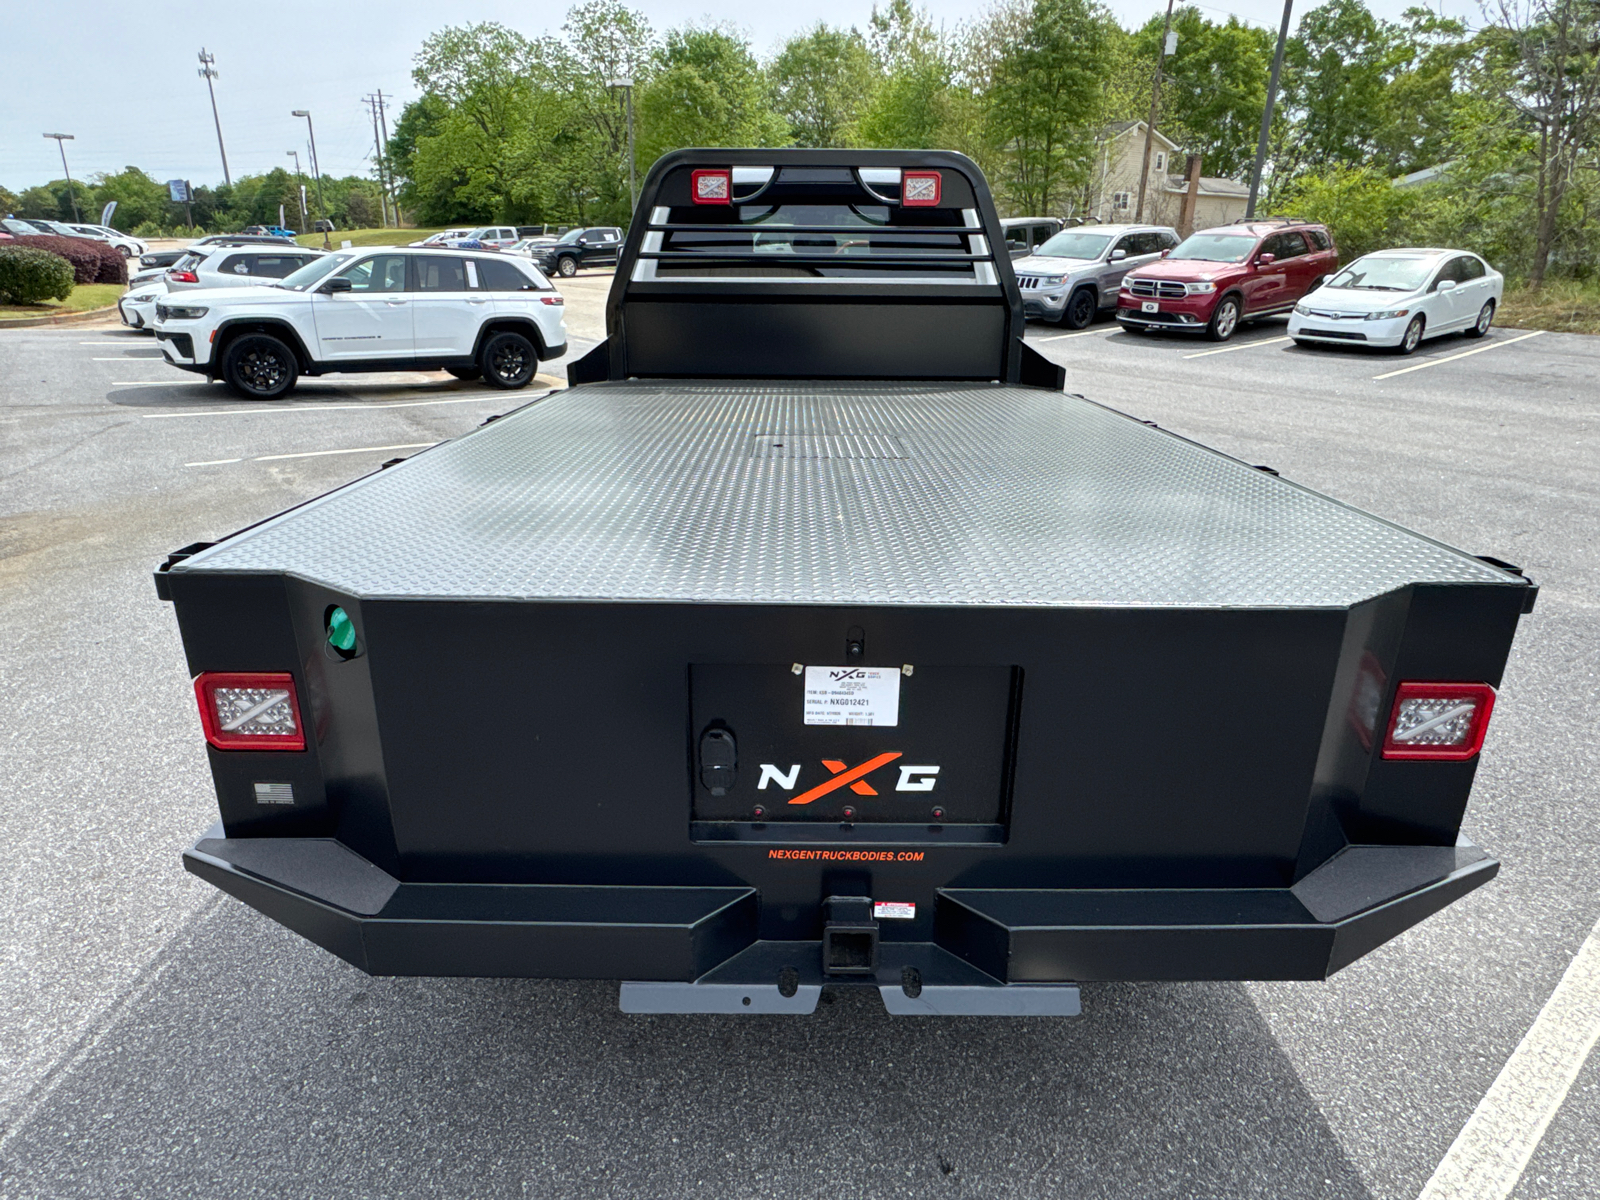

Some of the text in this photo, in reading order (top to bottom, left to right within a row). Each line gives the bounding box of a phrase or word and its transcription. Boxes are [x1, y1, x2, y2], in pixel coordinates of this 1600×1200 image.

[829, 668, 866, 681] NXG
[830, 698, 869, 706] NXG012421
[757, 752, 940, 804] NXG
[768, 849, 924, 861] NEXGENTRUCKBODIES.COM
